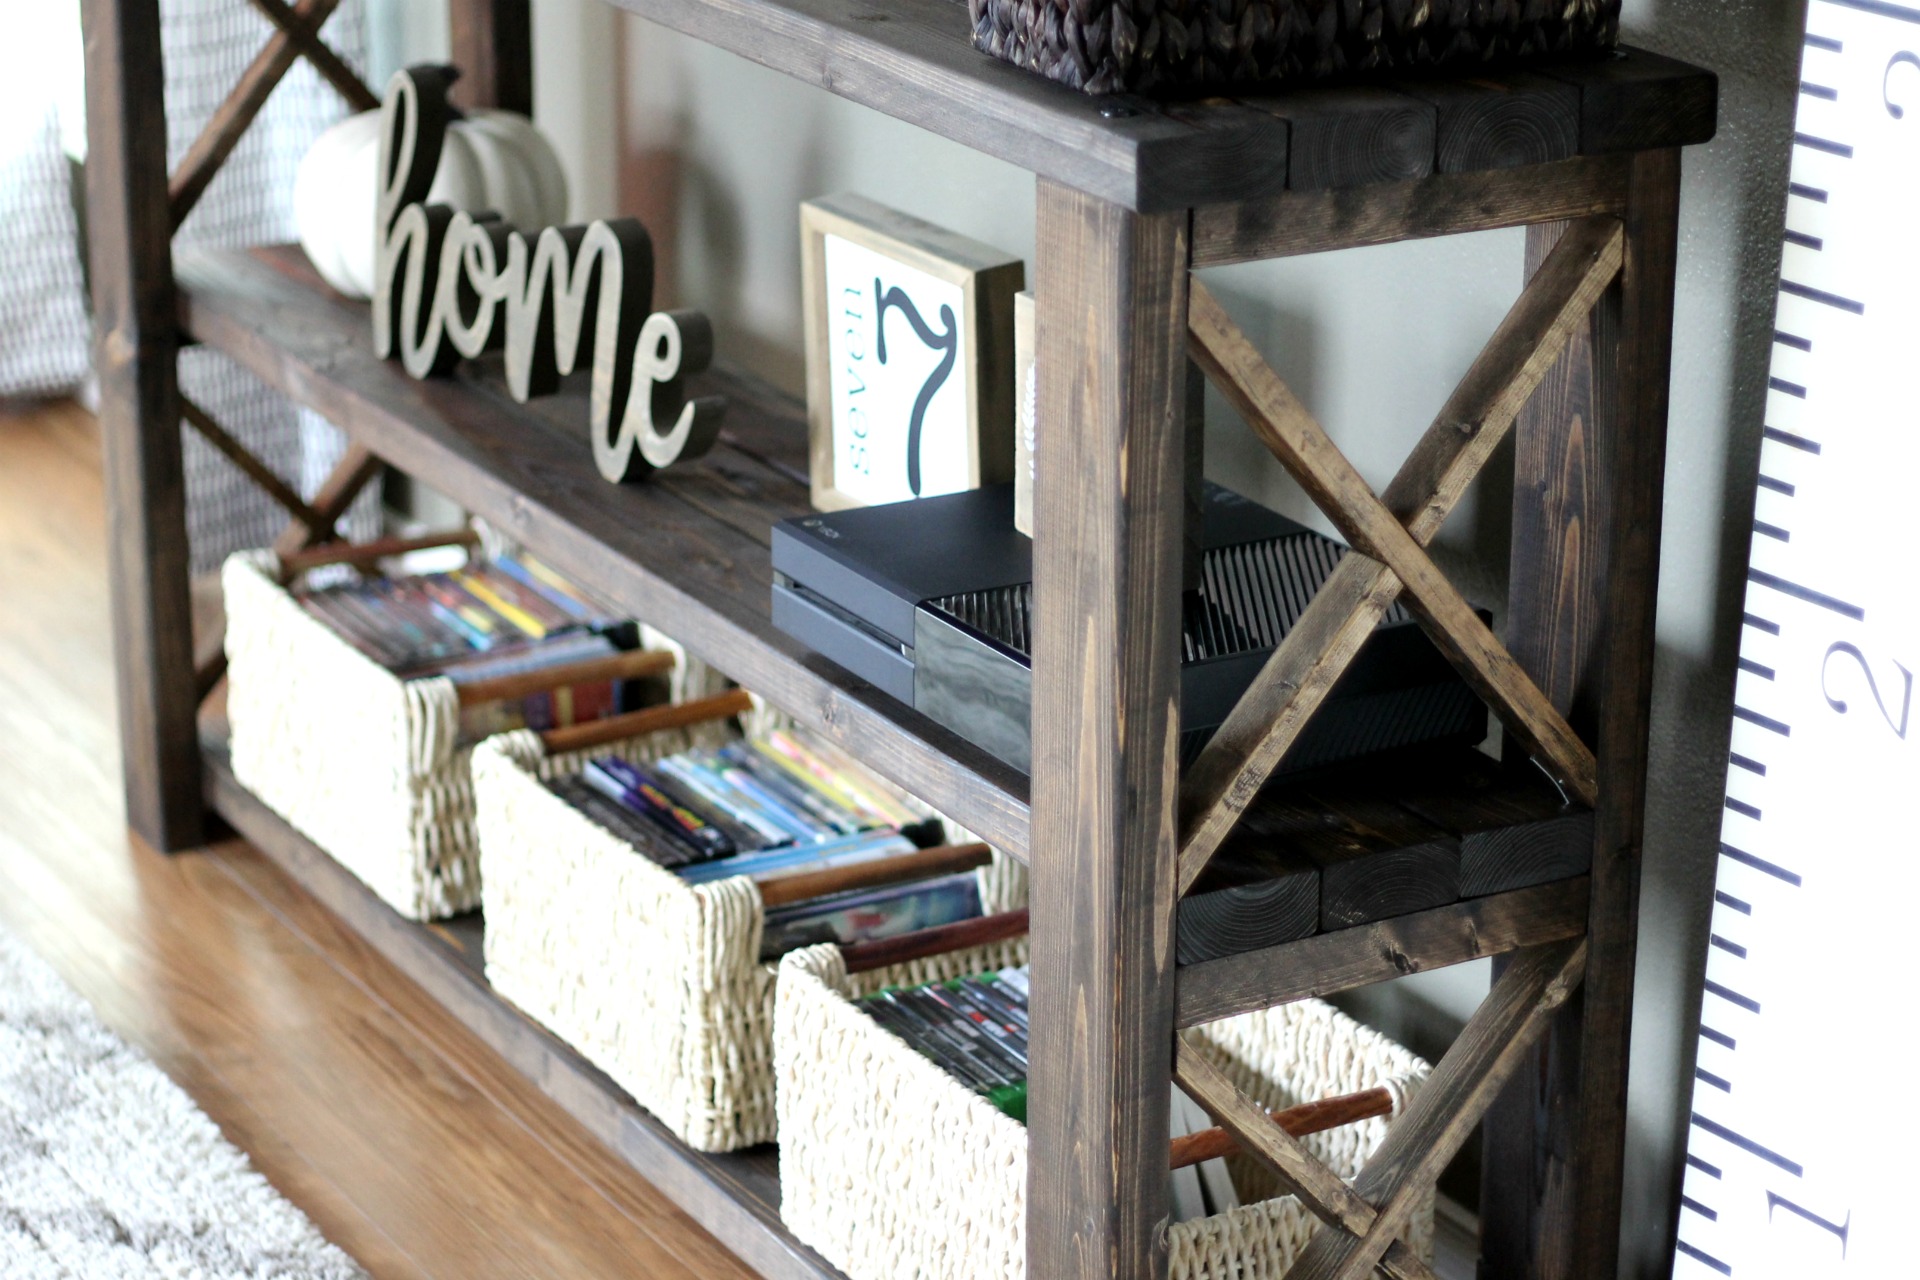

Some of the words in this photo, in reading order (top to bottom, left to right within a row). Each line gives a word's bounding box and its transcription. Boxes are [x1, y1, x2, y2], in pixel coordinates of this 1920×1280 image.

[371, 69, 696, 484] home
[844, 287, 869, 476] seven
[875, 277, 957, 497] 7
[1822, 640, 1913, 741] 2
[1765, 1188, 1851, 1261] 1
